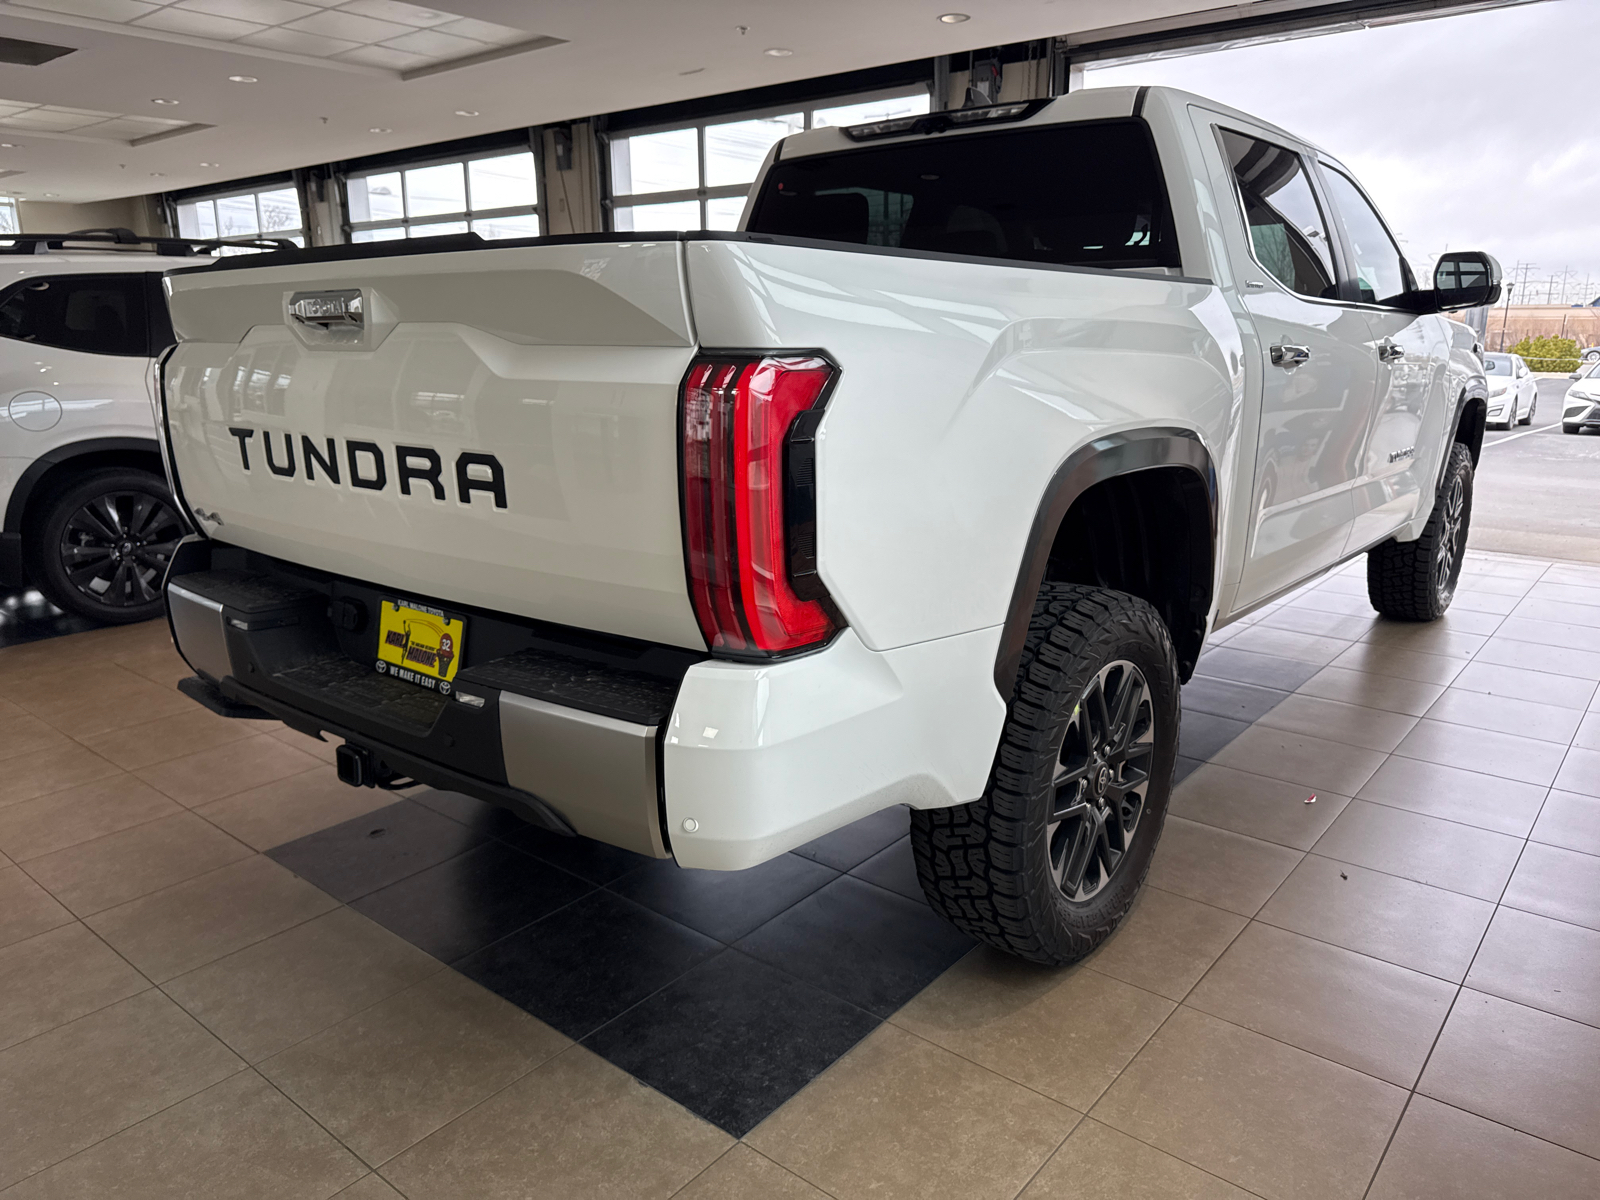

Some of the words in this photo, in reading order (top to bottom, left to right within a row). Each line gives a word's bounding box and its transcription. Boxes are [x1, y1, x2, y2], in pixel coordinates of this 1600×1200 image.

[228, 427, 508, 509] TUNDRA
[409, 602, 427, 612] MALONE
[385, 630, 405, 648] KARL
[442, 639, 451, 651] 32
[406, 646, 437, 668] MALONE
[390, 666, 398, 676] WE
[399, 668, 414, 682] MAKE
[415, 674, 420, 684] IT
[421, 677, 435, 689] EASY
